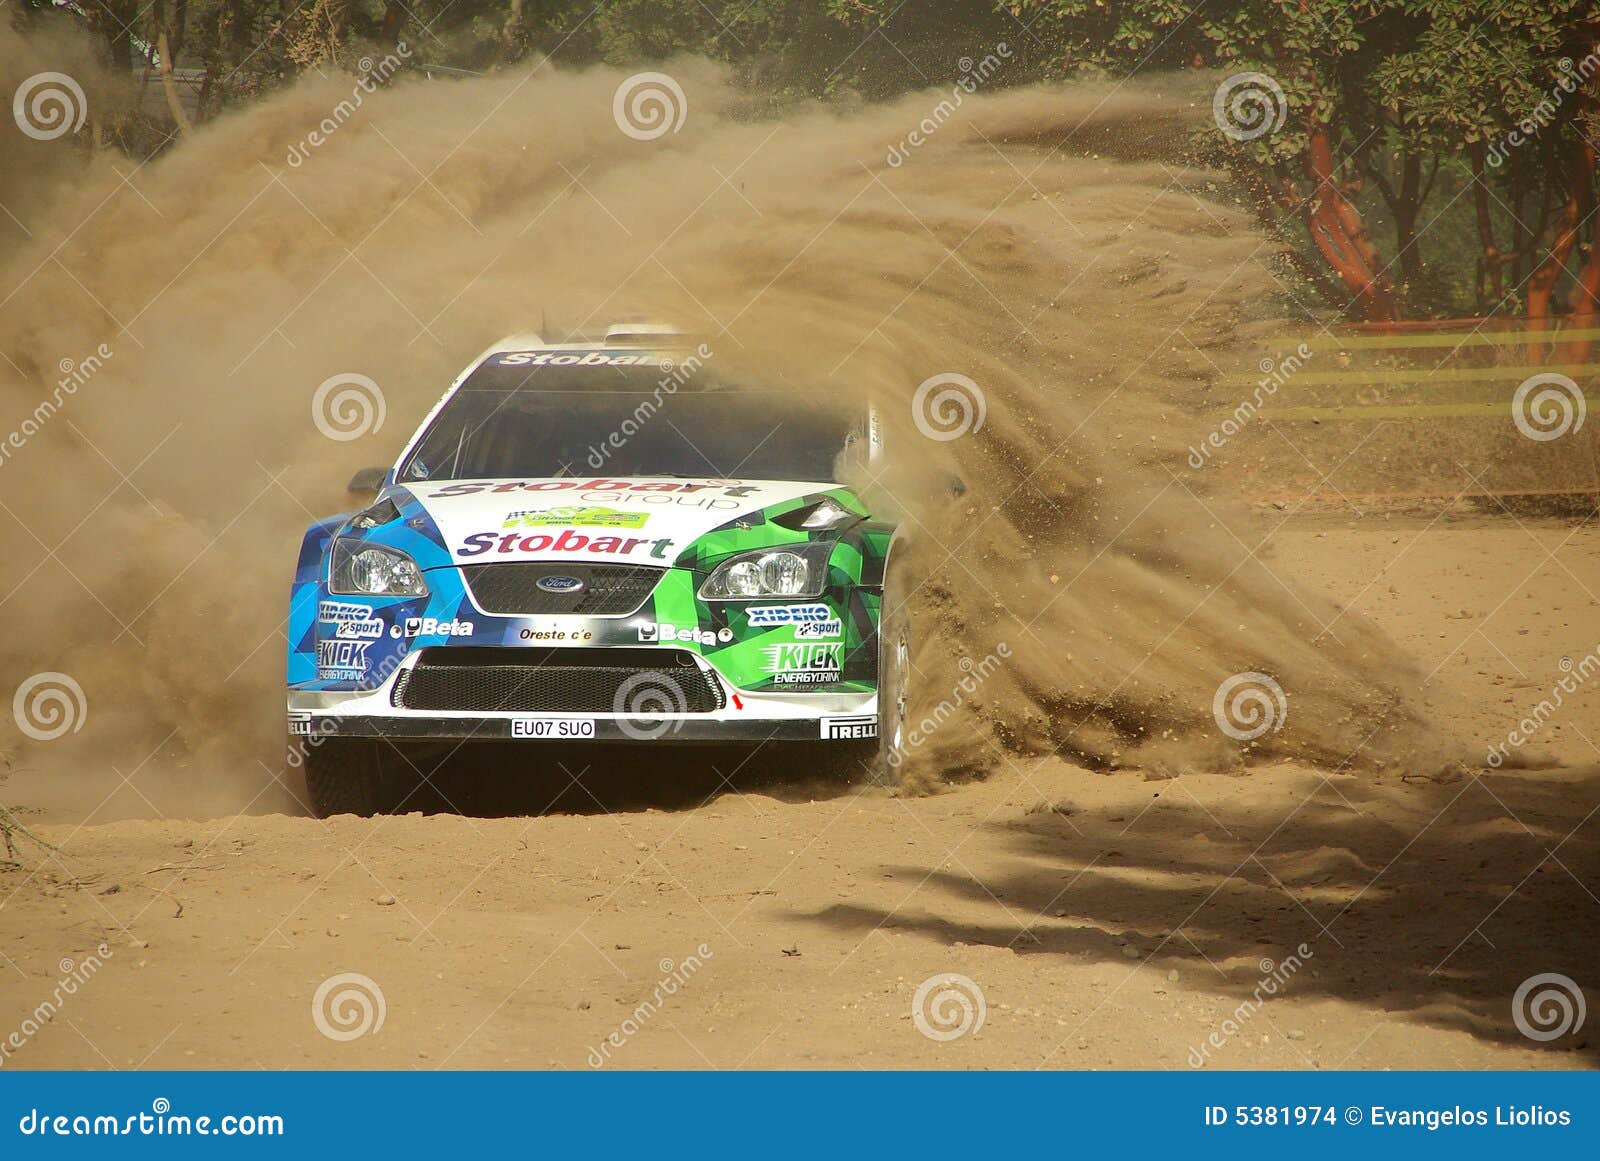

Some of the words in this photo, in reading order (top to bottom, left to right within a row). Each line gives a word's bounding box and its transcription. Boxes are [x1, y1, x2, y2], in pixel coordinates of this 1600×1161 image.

[500, 352, 655, 366] Stobar
[427, 479, 762, 498] Stobart
[580, 491, 740, 510] Group
[457, 530, 675, 559] Stobart
[545, 576, 573, 587] Ford
[751, 607, 829, 622] XIDEKO
[350, 621, 381, 634] sport
[418, 617, 474, 636] Beta
[519, 628, 565, 640] Oreste
[659, 623, 717, 646] Beta
[812, 621, 840, 635] sport
[319, 640, 374, 669] KICK
[776, 642, 844, 672] KICK
[514, 721, 553, 736] EU07
[558, 721, 593, 736] SUO
